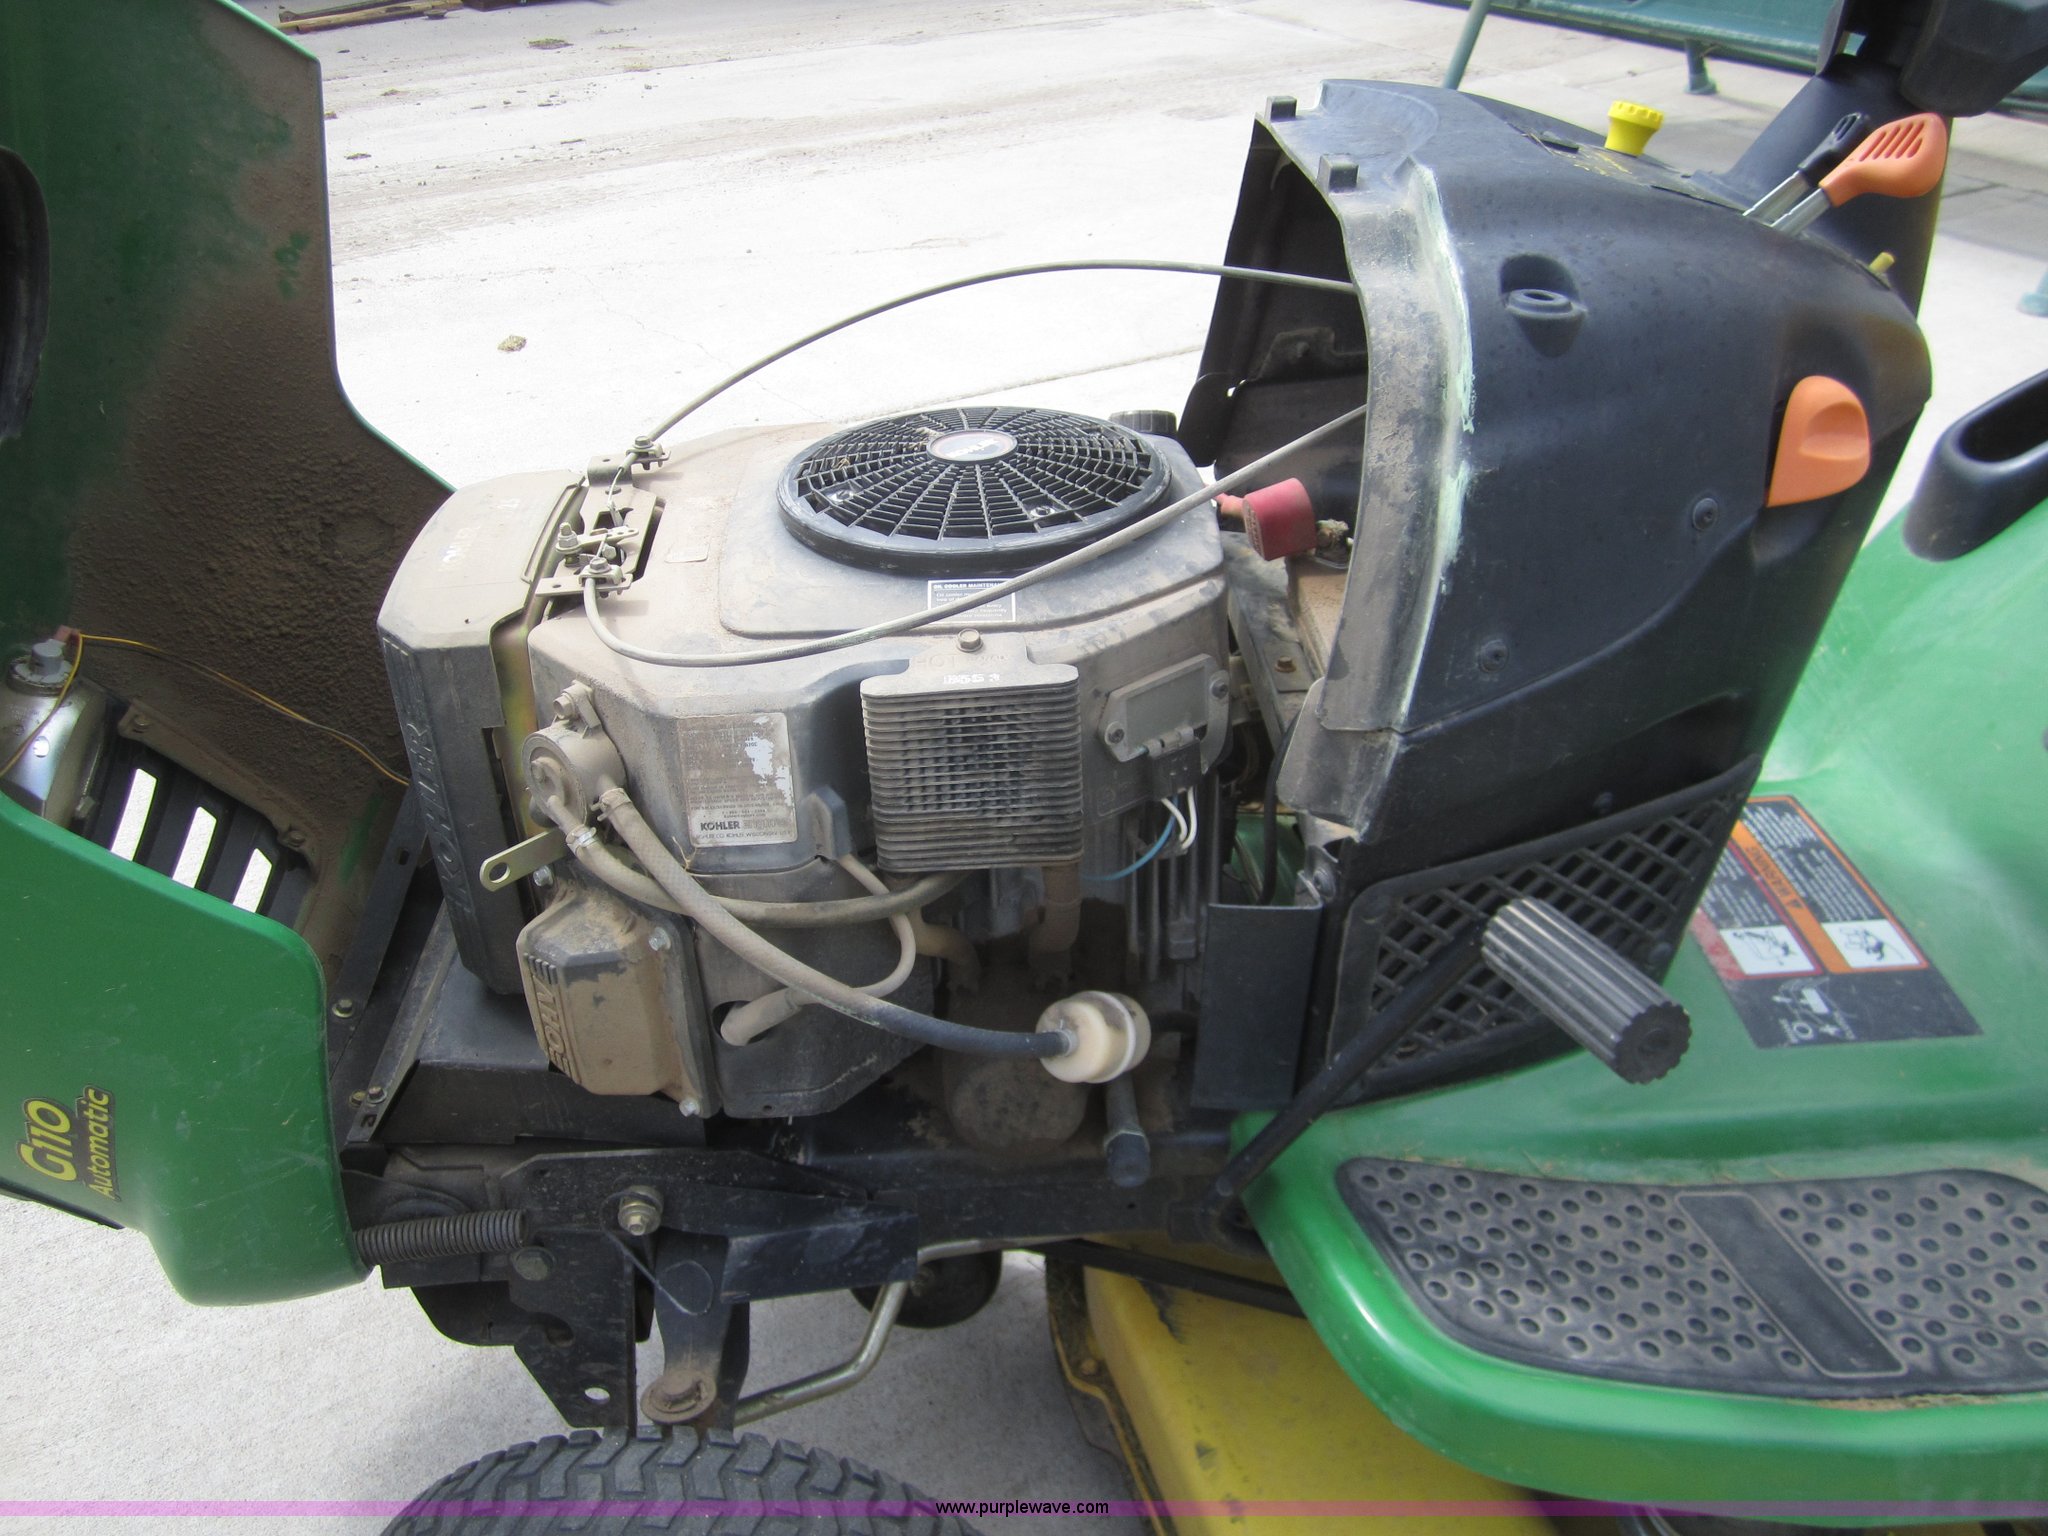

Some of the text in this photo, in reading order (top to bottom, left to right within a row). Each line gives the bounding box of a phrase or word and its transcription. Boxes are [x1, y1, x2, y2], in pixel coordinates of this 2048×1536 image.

[700, 820, 740, 831] KOHLER
[20, 1100, 77, 1181] G110
[81, 1088, 115, 1200] Automatic
